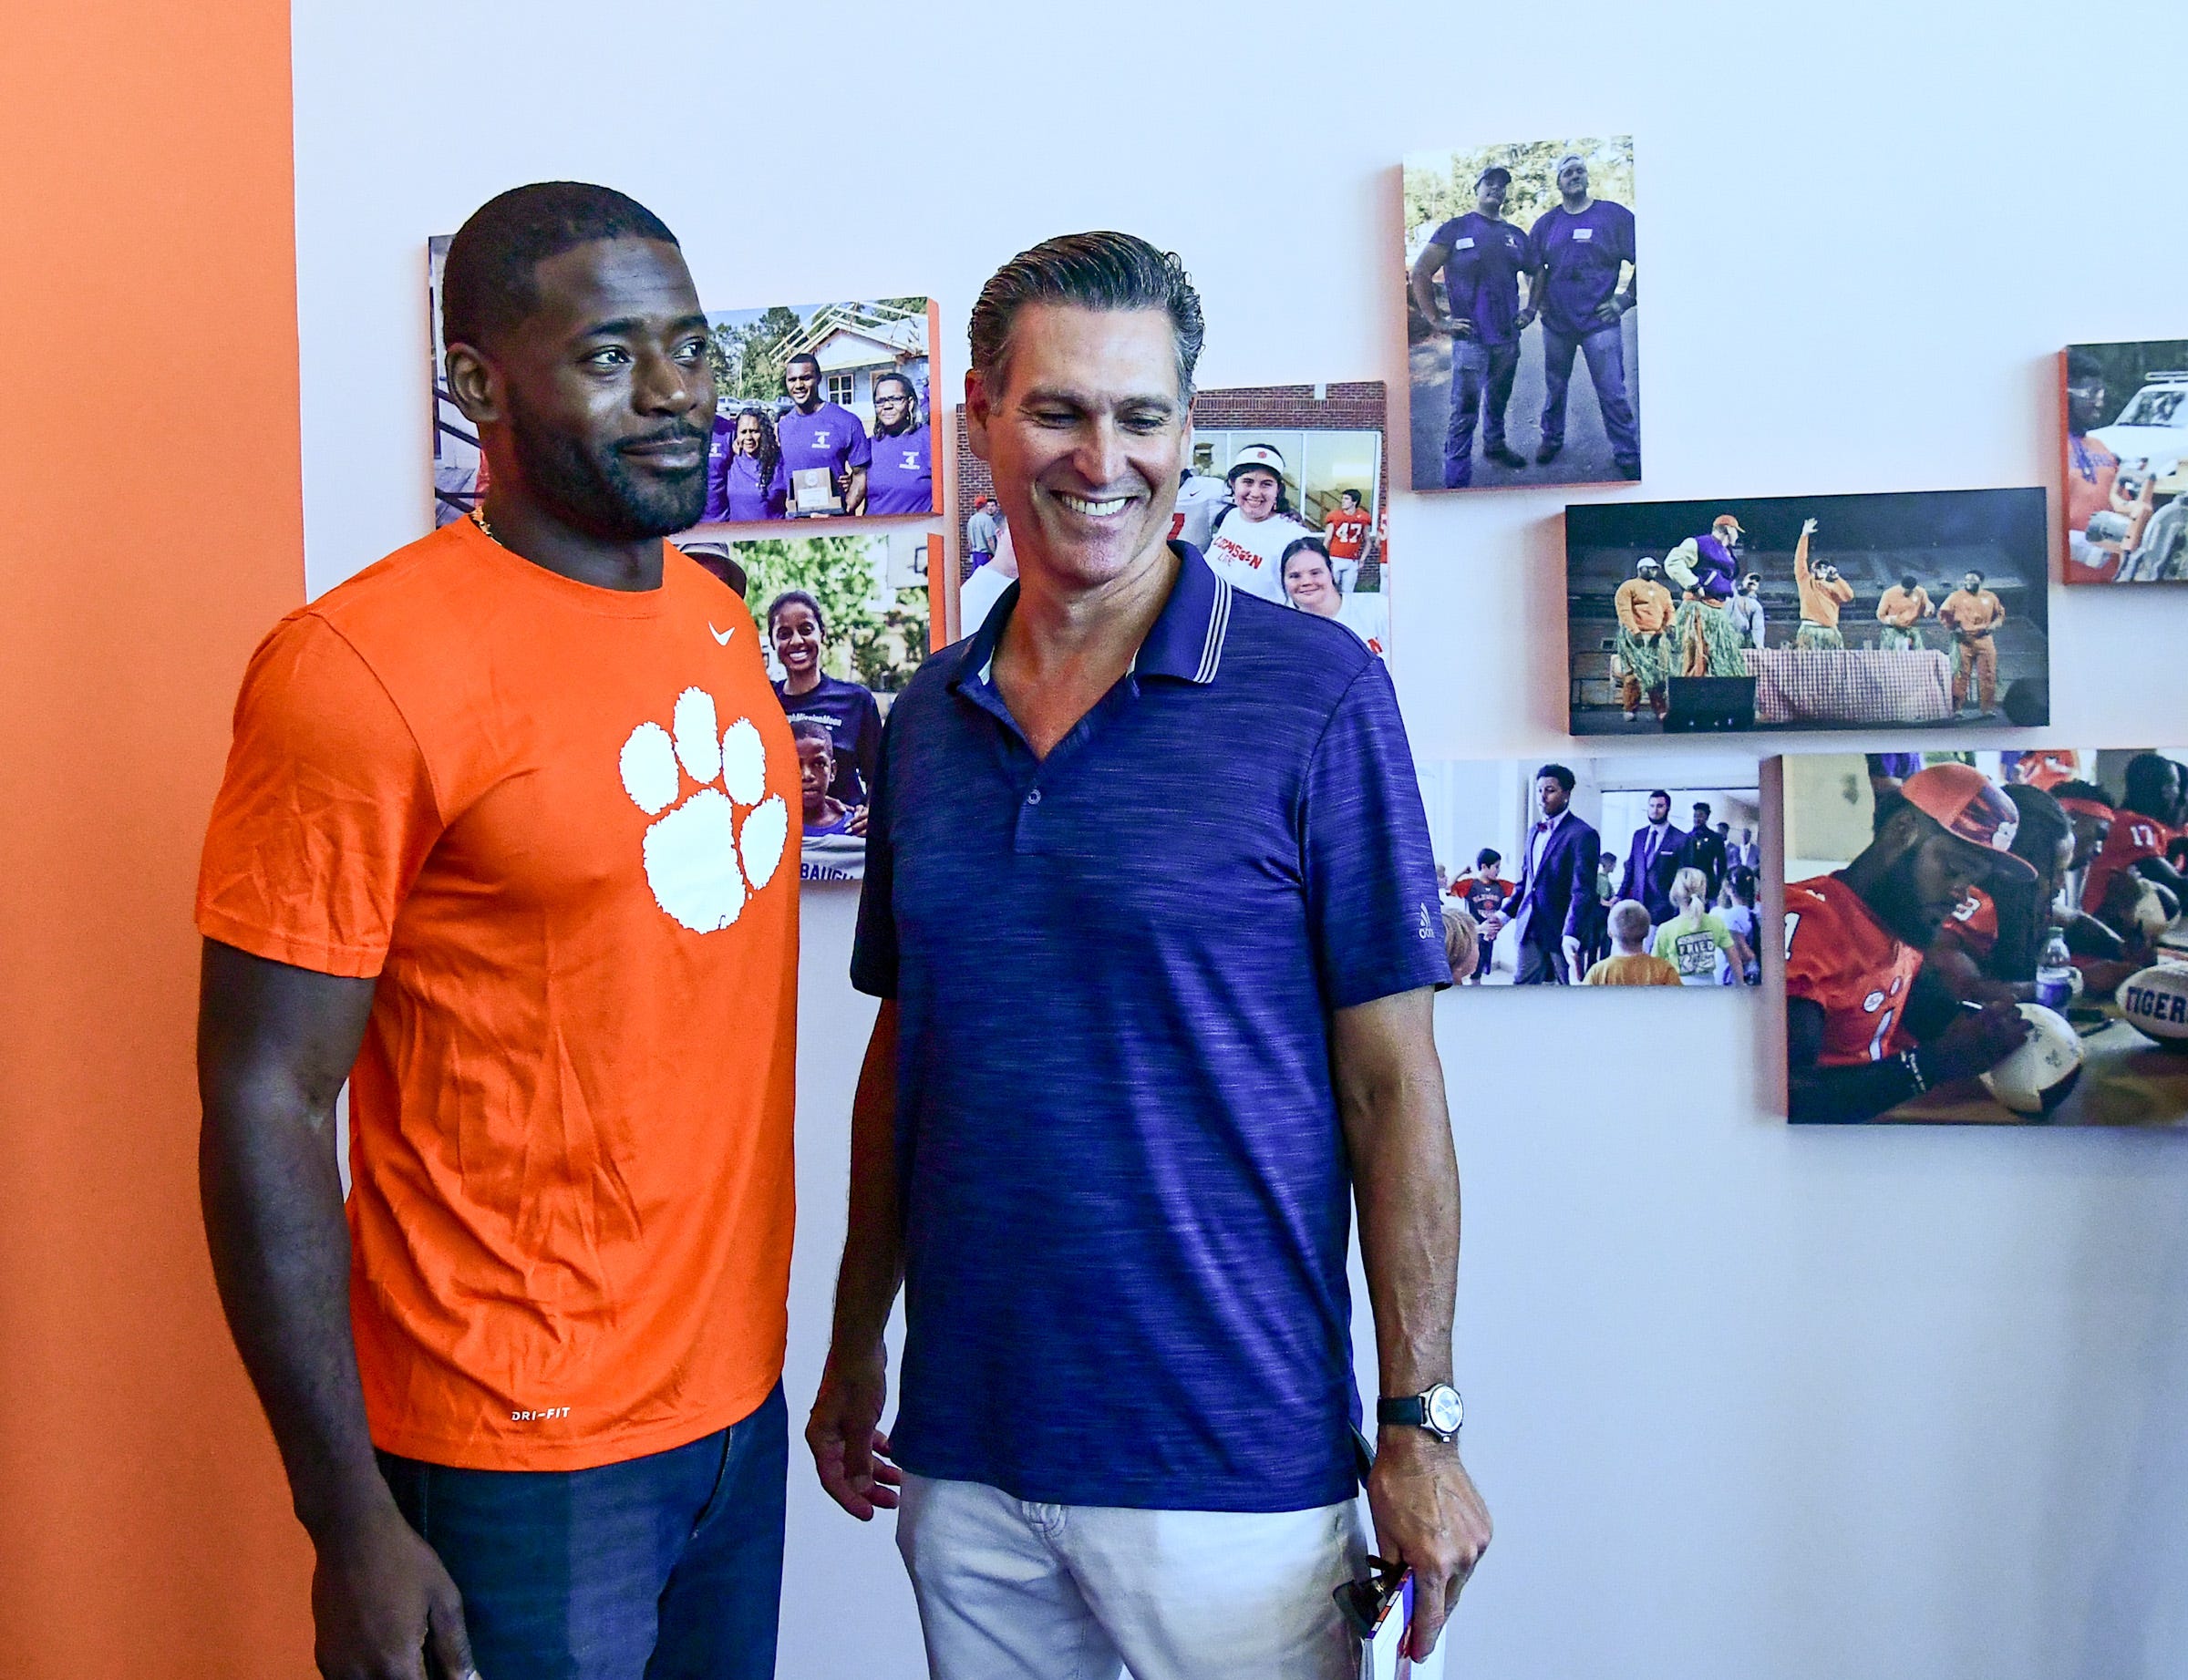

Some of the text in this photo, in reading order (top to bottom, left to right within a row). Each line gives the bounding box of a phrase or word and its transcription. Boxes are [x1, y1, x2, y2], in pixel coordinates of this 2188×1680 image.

[1335, 521, 1363, 544] 47
[2126, 985, 2188, 1025] TIGER
[511, 1407, 571, 1421] DRI-FIT
